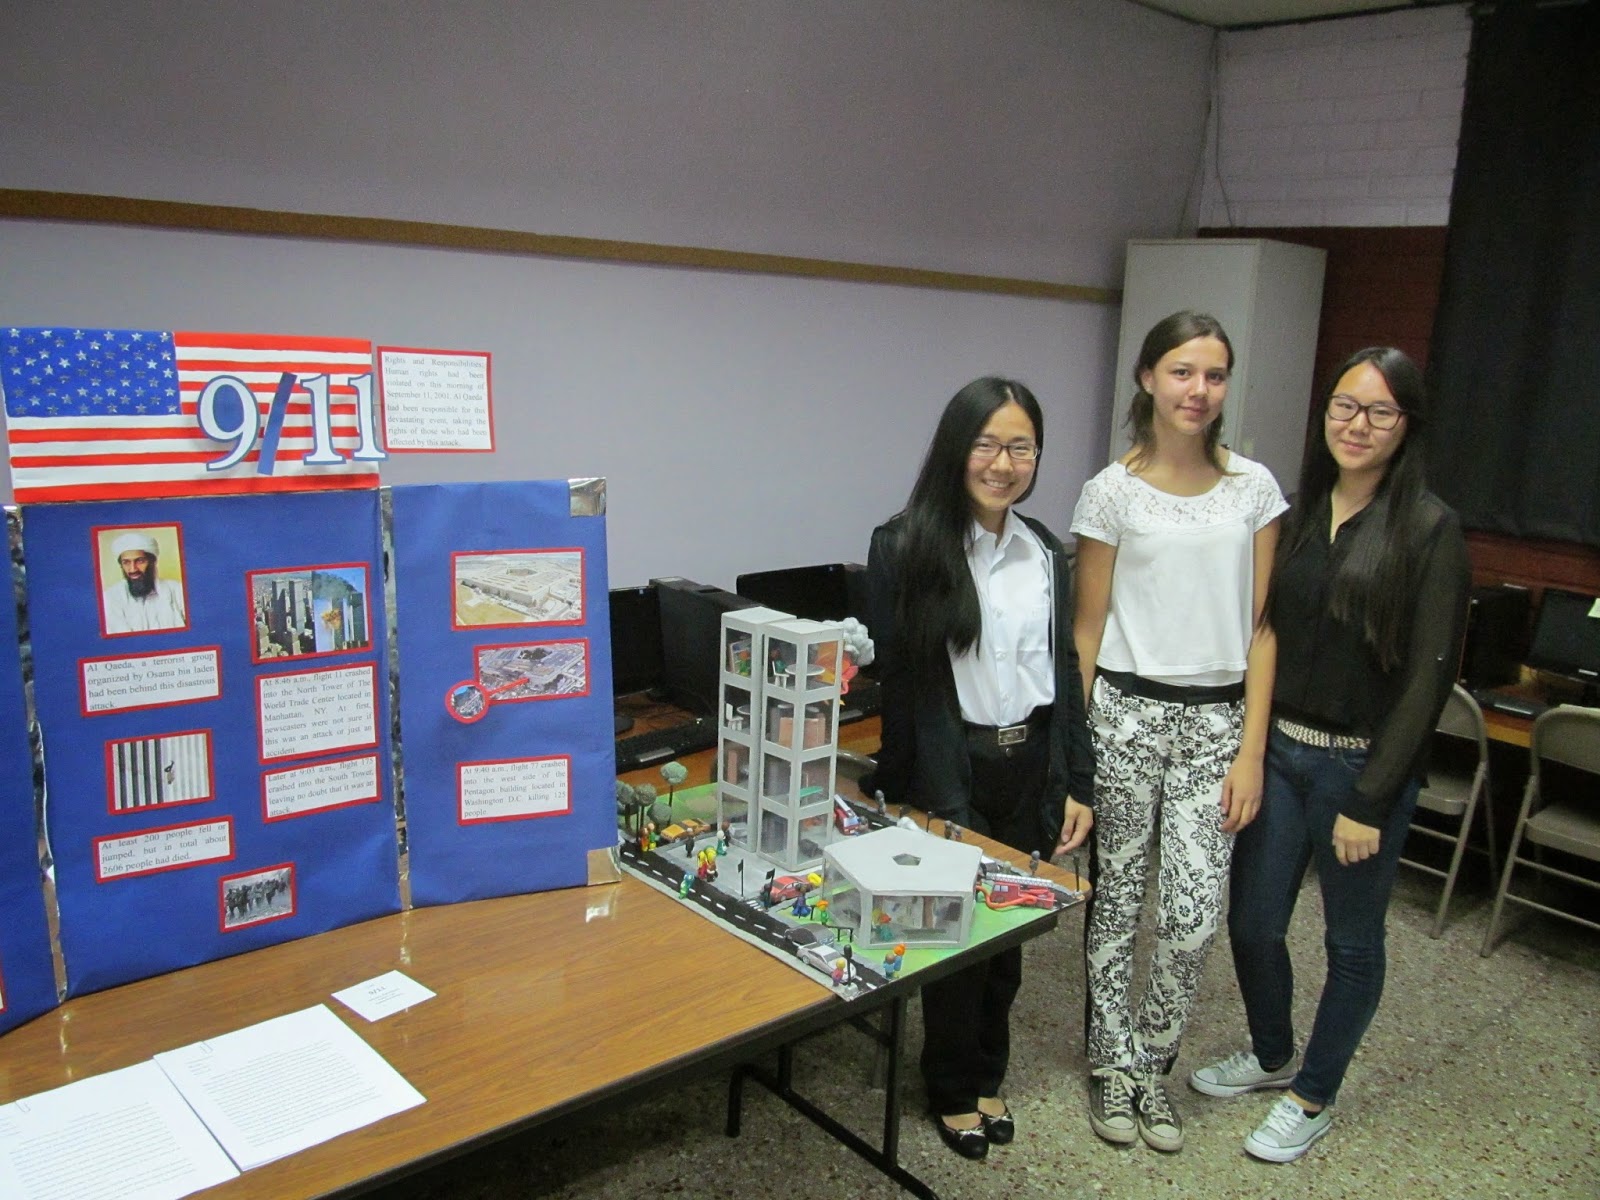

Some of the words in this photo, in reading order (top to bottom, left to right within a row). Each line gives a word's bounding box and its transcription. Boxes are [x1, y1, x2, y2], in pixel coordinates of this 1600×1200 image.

[385, 356, 405, 364] Rights
[387, 391, 420, 399] September
[197, 372, 388, 476] 9/11
[388, 416, 424, 424] devastating
[453, 418, 472, 426] taking
[87, 664, 98, 672] Al
[153, 656, 185, 665] terrorist
[191, 653, 214, 663] group
[88, 674, 129, 685] organized
[133, 672, 142, 681] by
[147, 669, 175, 678] Osama
[314, 673, 331, 681] flight
[345, 668, 370, 677] crashed
[88, 689, 104, 698] had
[129, 684, 157, 693] behind
[160, 682, 174, 690] this
[177, 678, 215, 687] disastrous
[322, 683, 343, 691] Tower
[264, 701, 285, 709] World
[312, 696, 334, 704] Center
[338, 692, 361, 700] located
[265, 723, 306, 733] newscasters
[313, 730, 332, 738] attack
[347, 727, 360, 735] just
[269, 773, 286, 781] Later
[340, 761, 357, 769] flight
[541, 760, 565, 768] crashed
[269, 783, 295, 793] crashed
[329, 774, 348, 782] South
[464, 788, 494, 797] Pentagon
[500, 785, 526, 793] building
[532, 782, 554, 790] located
[269, 795, 294, 805] leaving
[308, 790, 327, 798] doubt
[464, 797, 503, 805] Washington
[464, 809, 486, 817] people
[102, 842, 111, 850] At
[118, 838, 137, 847] least
[144, 834, 159, 843] 200
[166, 829, 192, 840] people
[199, 825, 211, 833] fell
[144, 846, 156, 854] but
[180, 839, 197, 848] total
[205, 835, 226, 844] about
[103, 863, 122, 874] 2606
[126, 859, 152, 871] people
[155, 856, 170, 864] had
